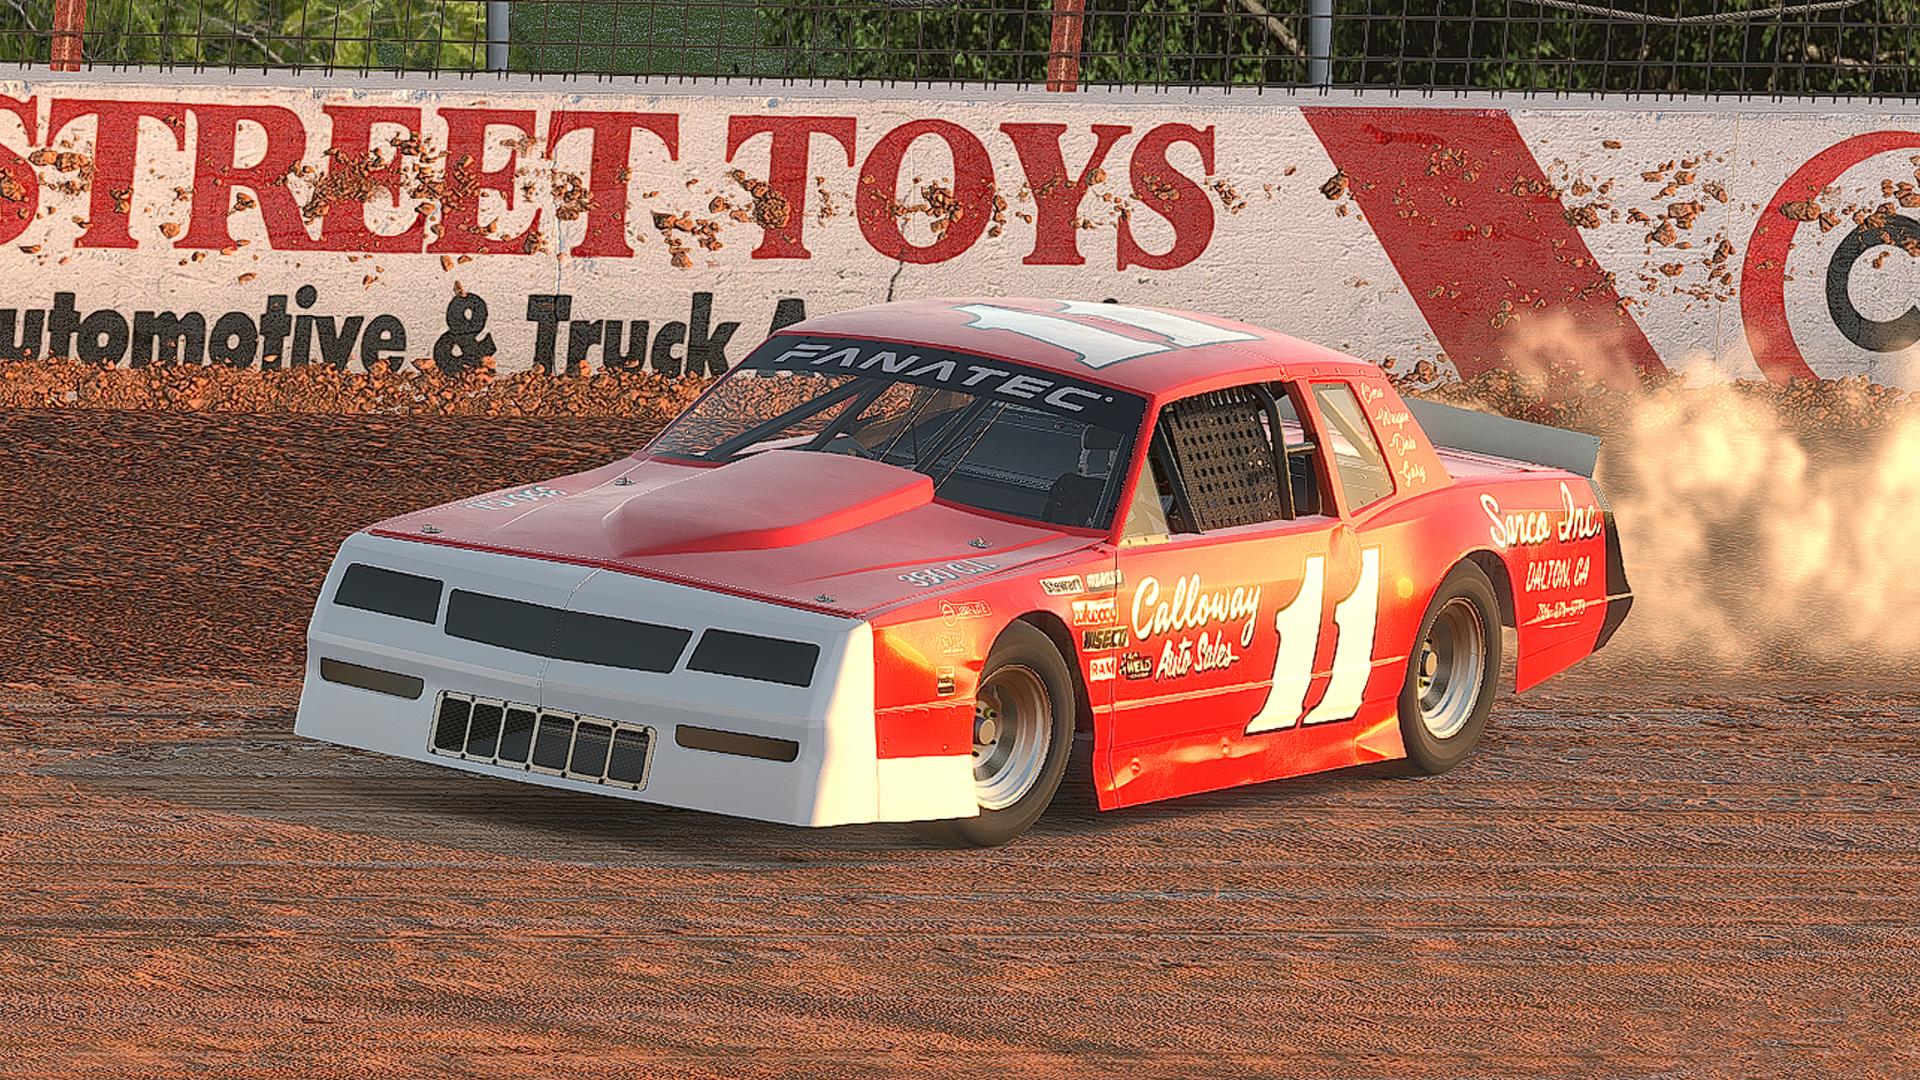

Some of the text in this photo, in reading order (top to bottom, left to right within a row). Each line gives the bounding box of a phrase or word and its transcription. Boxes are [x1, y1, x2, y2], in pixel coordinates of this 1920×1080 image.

[726, 115, 1216, 271] TOYS
[433, 292, 498, 377] &
[526, 292, 741, 379] Truck
[773, 343, 1102, 412] FANATEC
[1557, 481, 1602, 542] Inc.
[1042, 577, 1082, 593] Stewart
[1525, 557, 1572, 592] DALTON,
[1131, 573, 1263, 648] Calloway
[1244, 546, 1382, 736] 11
[1155, 631, 1240, 681] Auto Sales
